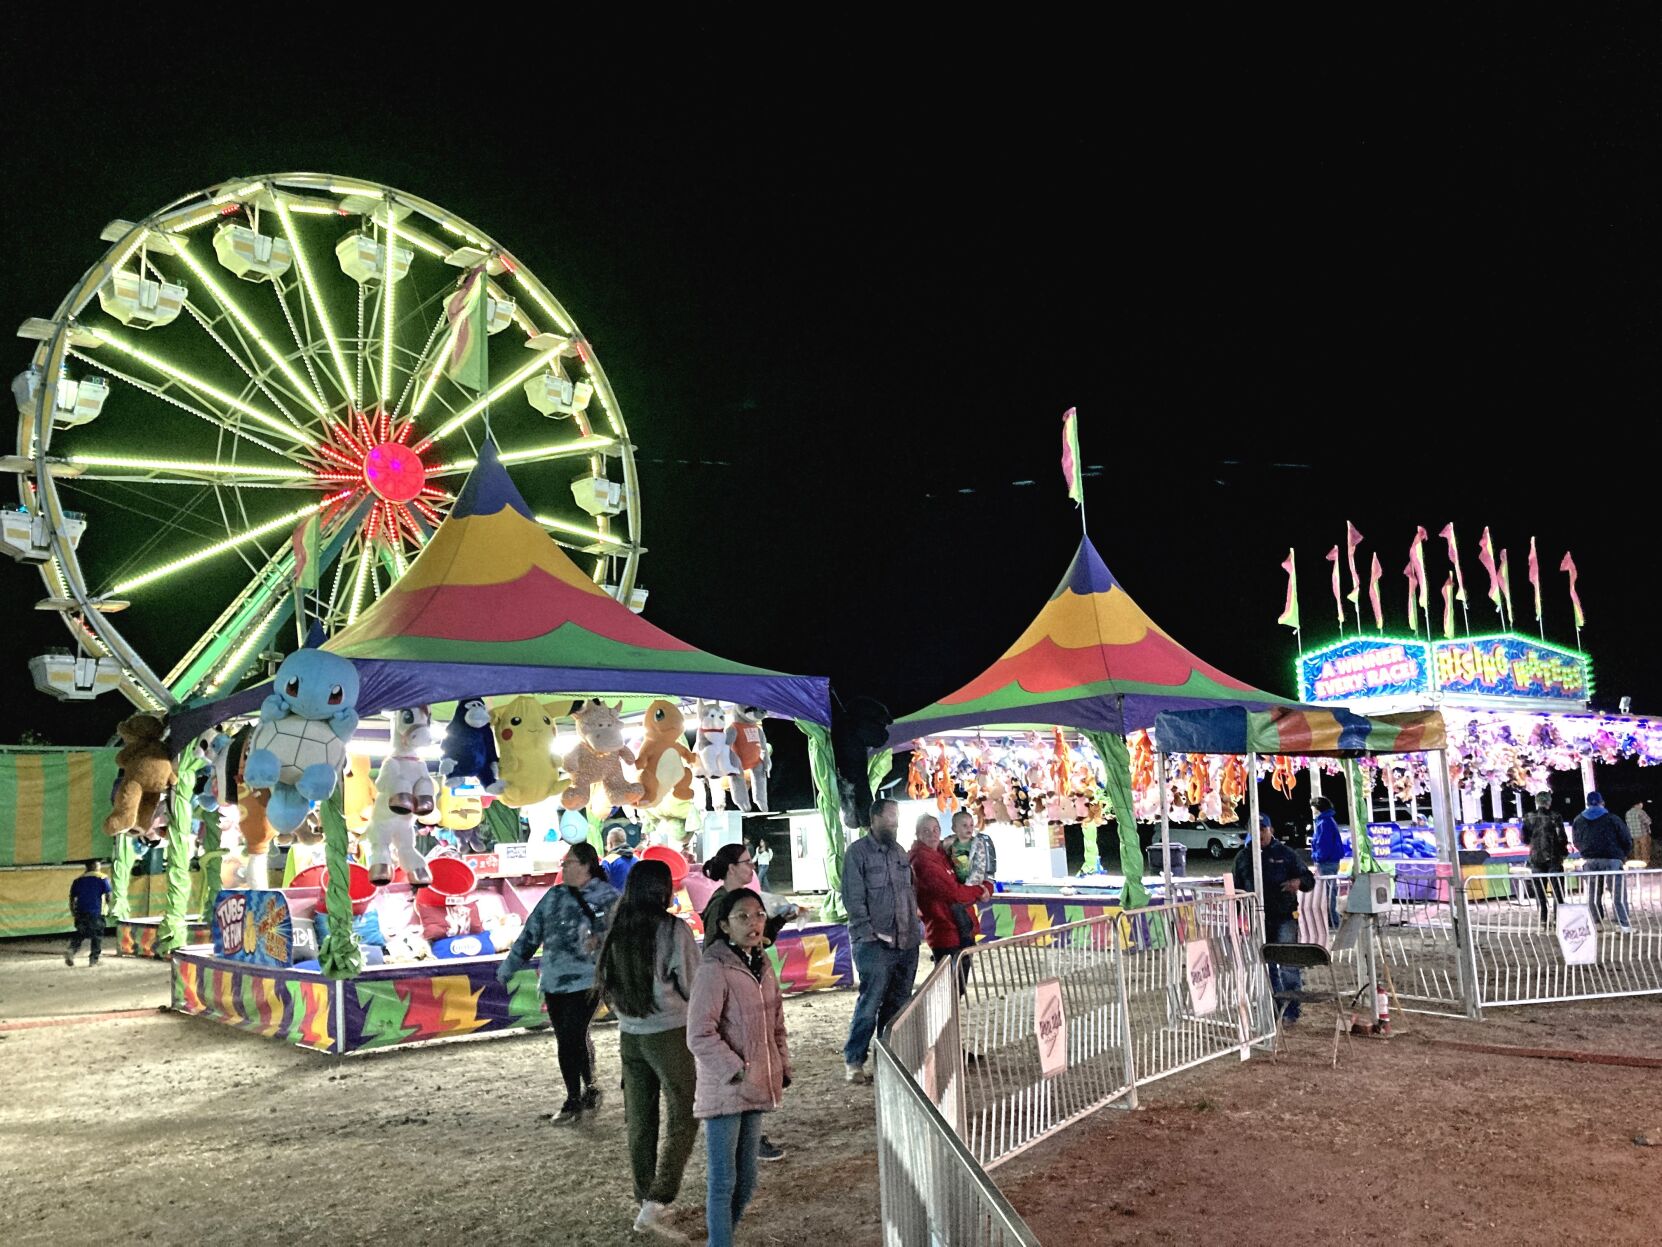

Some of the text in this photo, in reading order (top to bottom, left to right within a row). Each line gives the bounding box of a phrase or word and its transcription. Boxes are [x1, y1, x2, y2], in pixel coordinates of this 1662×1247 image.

[1322, 645, 1404, 678] A WINNER
[1439, 645, 1508, 686] RISING
[1316, 661, 1418, 698] EVERY RACE!
[217, 898, 245, 929] TUBS
[223, 921, 242, 950] OF FUN
